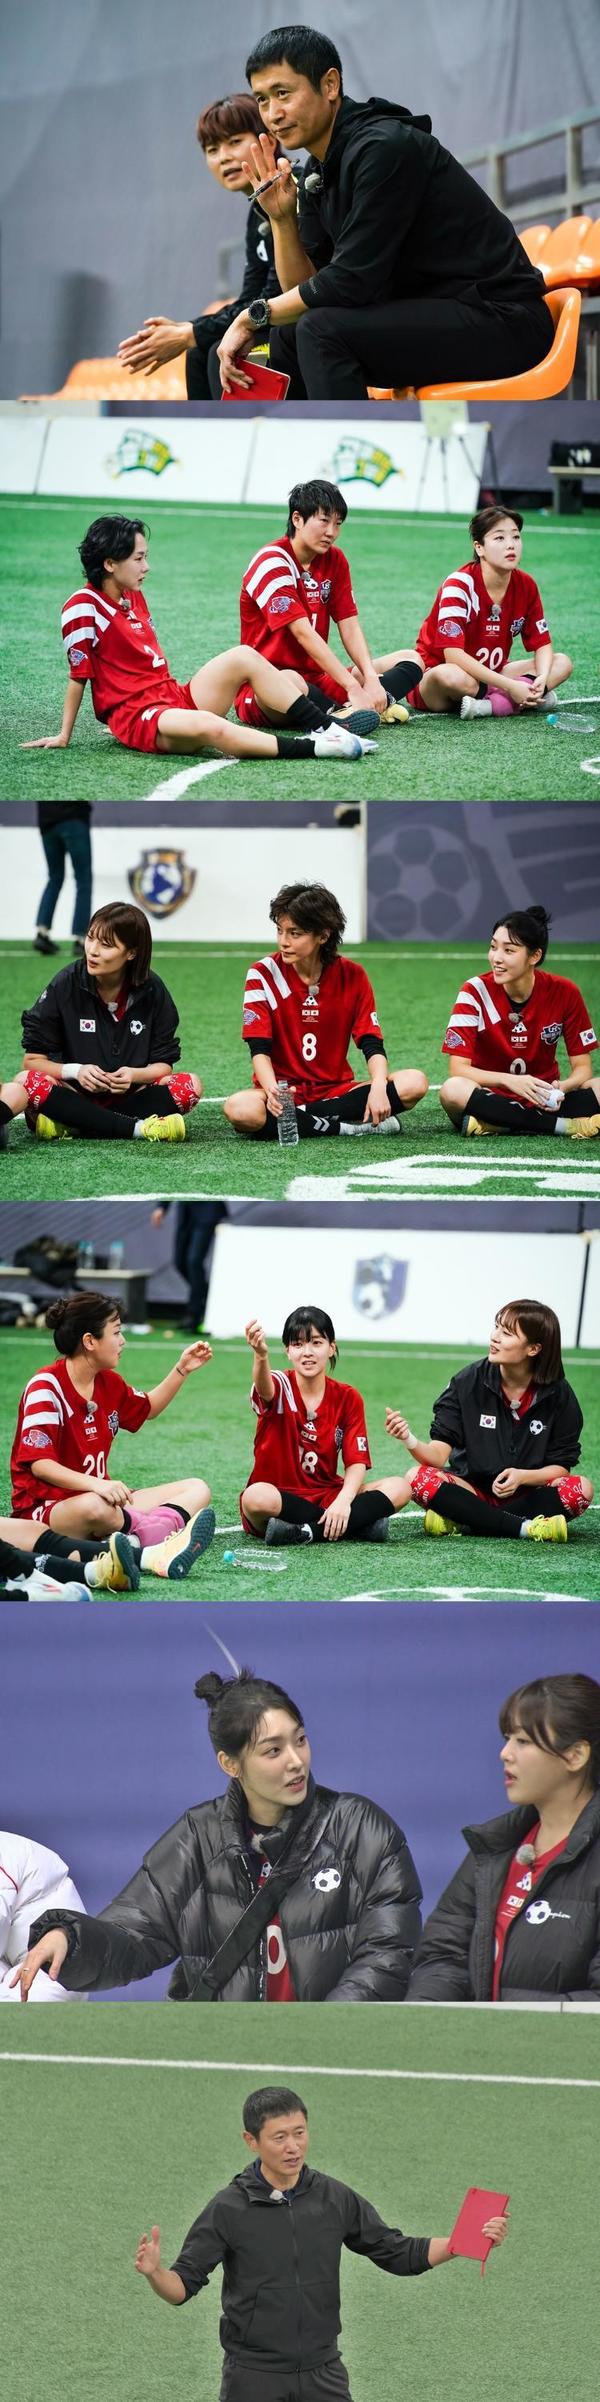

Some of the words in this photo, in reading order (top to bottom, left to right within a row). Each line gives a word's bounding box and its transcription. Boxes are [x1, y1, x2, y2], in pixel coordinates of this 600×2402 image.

[144, 645, 166, 668] 2
[476, 647, 504, 670] 20
[302, 1033, 317, 1061] 8
[83, 1451, 105, 1480] 20
